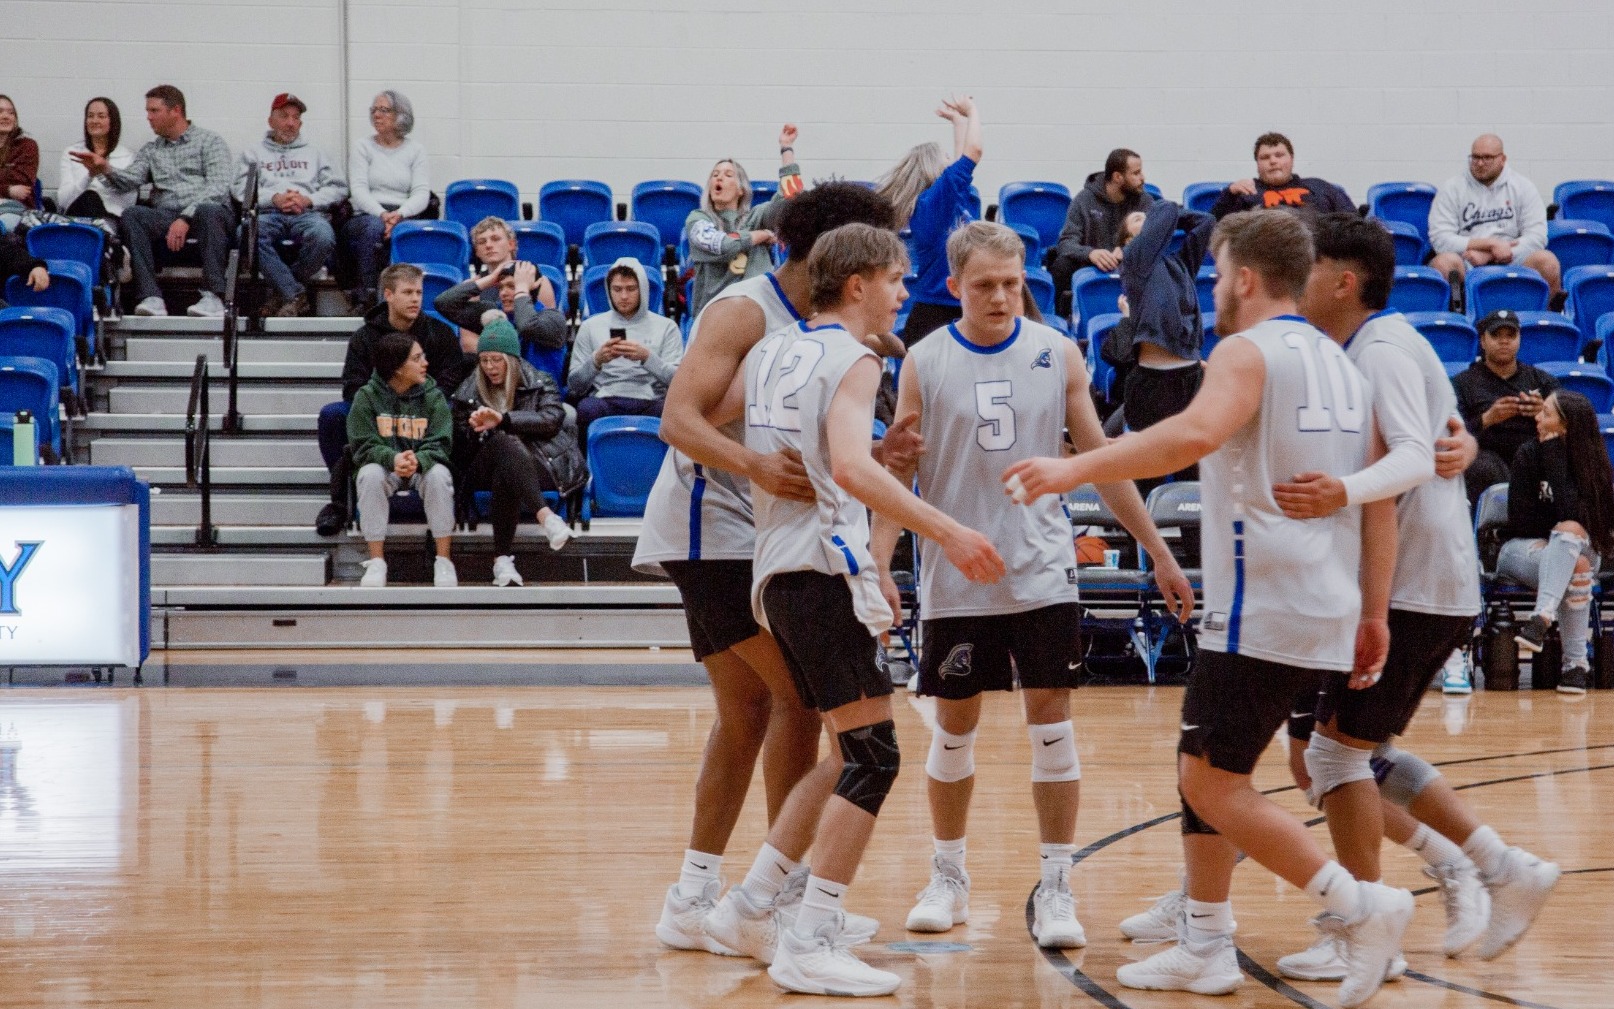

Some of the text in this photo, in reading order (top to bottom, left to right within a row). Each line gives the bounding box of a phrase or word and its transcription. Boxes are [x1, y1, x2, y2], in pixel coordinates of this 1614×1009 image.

[749, 334, 825, 433] 12
[974, 380, 1017, 452] 5
[1281, 332, 1362, 434] 10
[1069, 502, 1101, 511] ARENA
[1177, 502, 1201, 511] AREN
